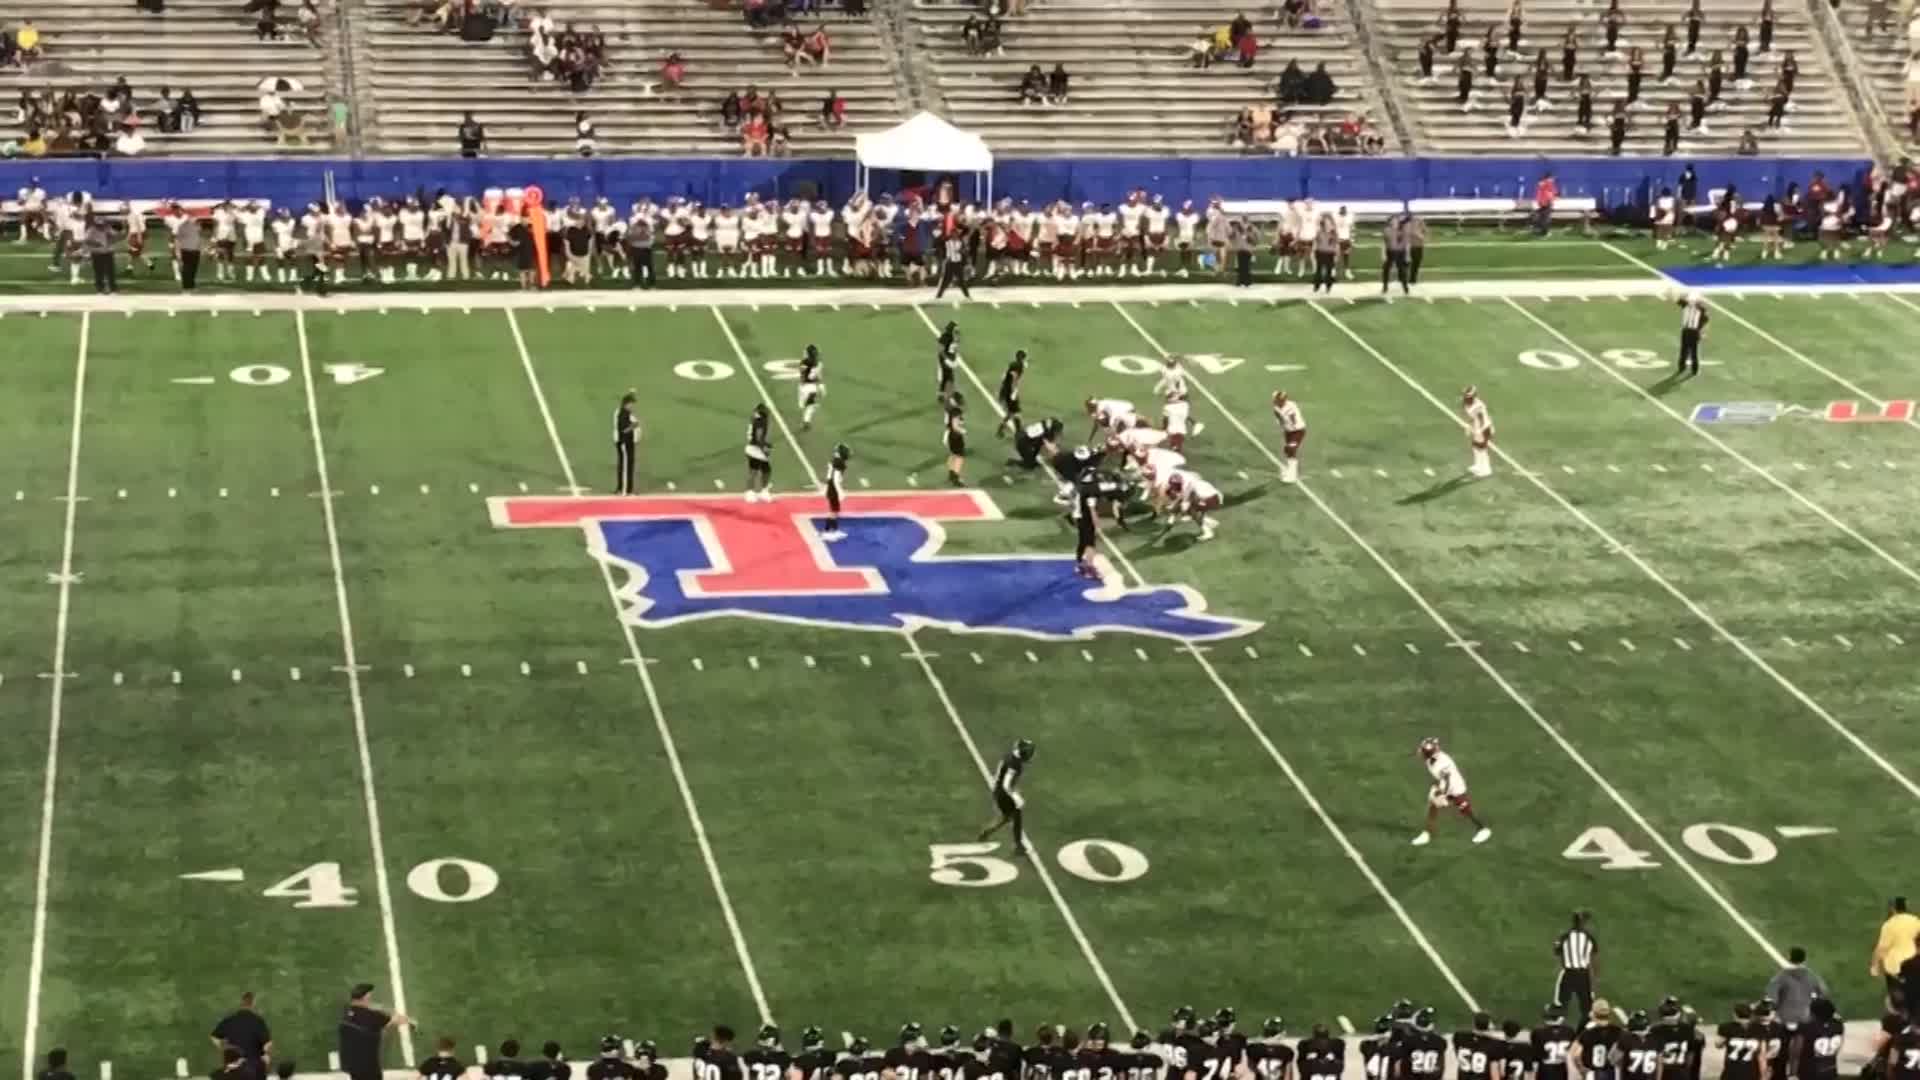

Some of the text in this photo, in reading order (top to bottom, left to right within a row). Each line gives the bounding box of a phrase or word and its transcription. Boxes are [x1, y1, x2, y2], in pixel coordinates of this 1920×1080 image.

[929, 838, 1149, 887] 50
[1562, 823, 1777, 870] 40
[262, 856, 499, 908] 40
